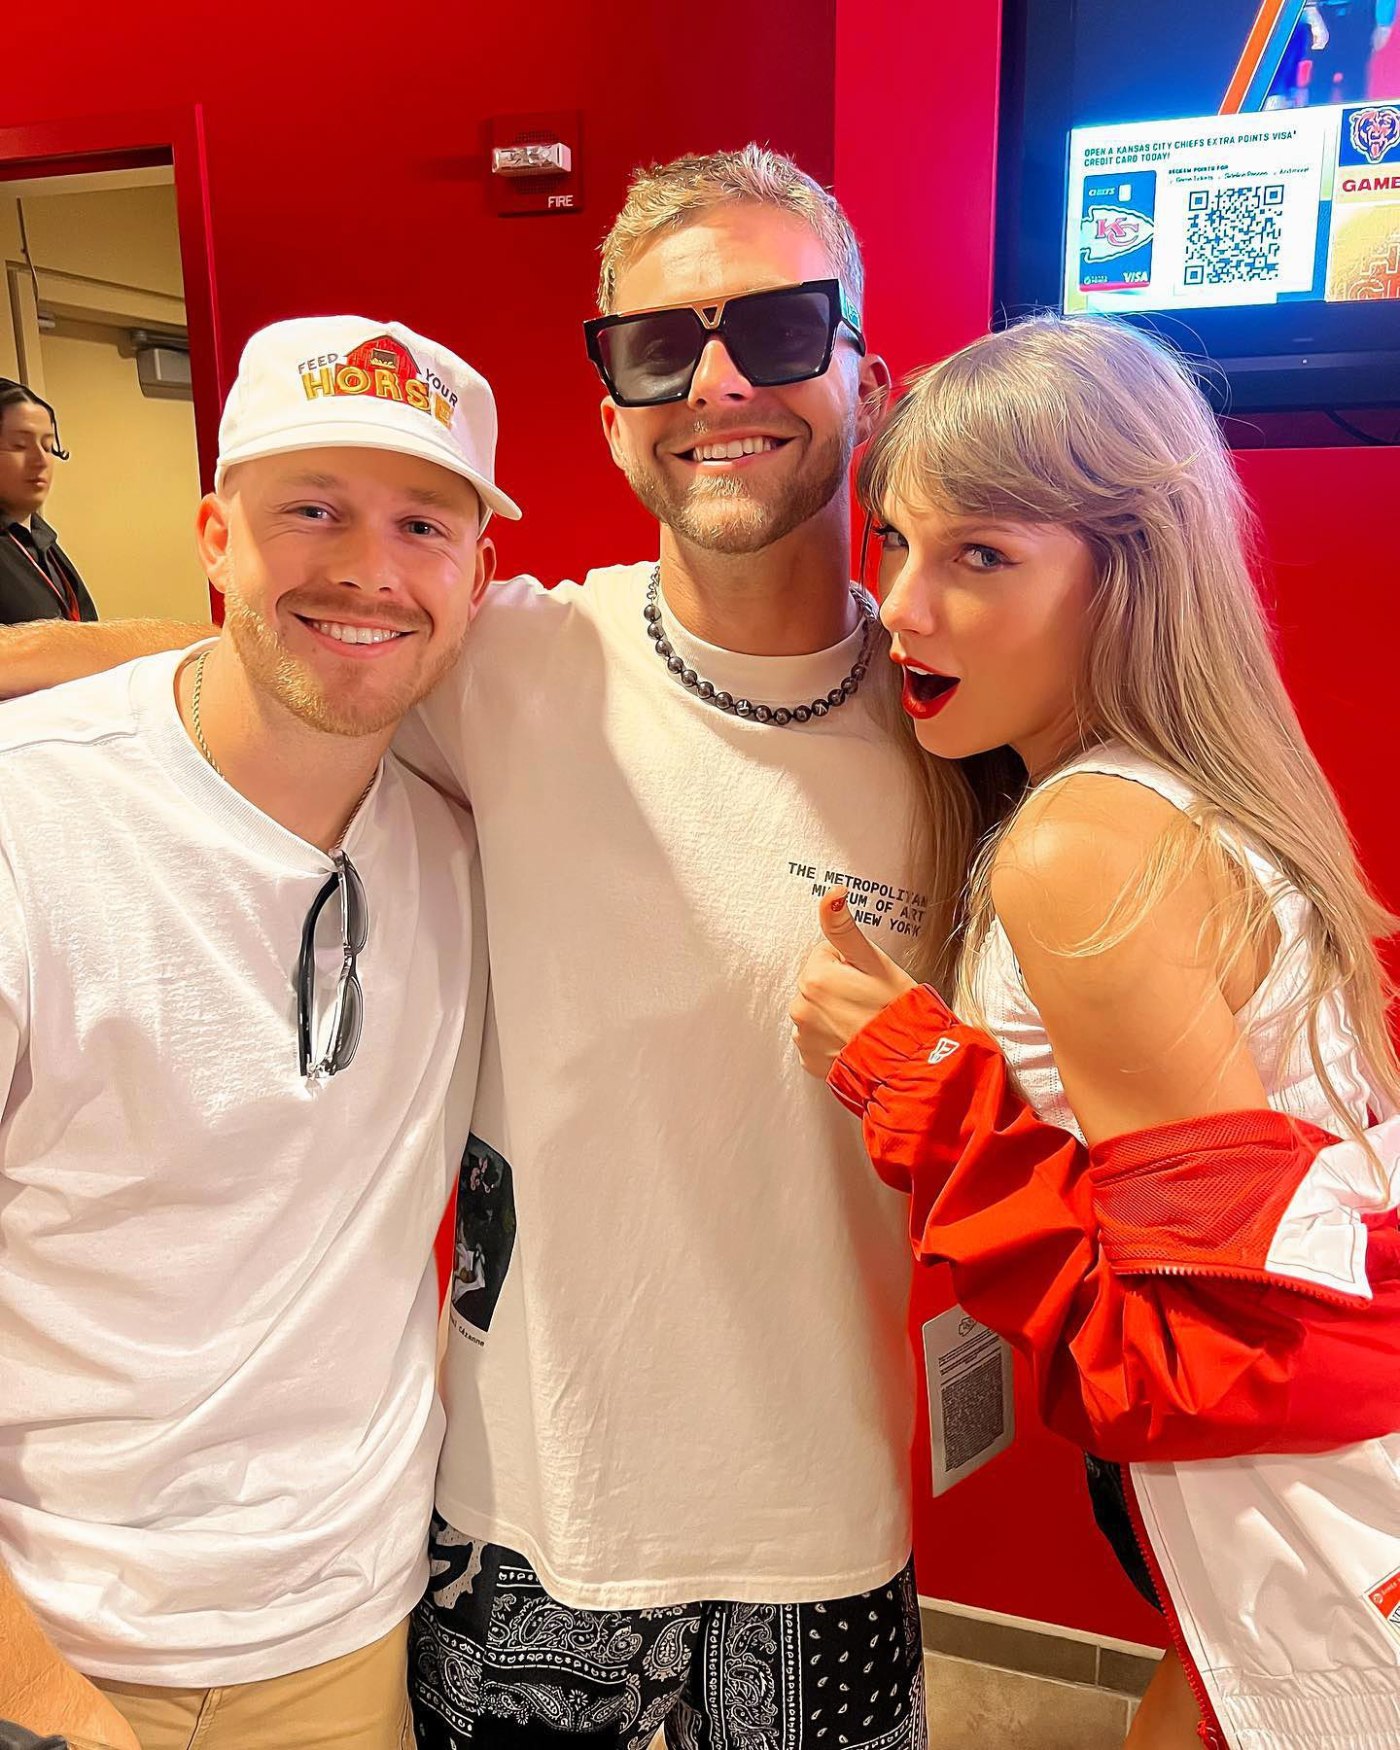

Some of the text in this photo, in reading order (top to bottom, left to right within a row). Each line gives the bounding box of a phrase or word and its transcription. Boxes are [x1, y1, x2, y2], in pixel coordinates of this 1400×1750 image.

[1084, 147, 1106, 157] OPEN
[1108, 147, 1114, 155] A
[1117, 143, 1150, 154] KANSAS
[1153, 141, 1172, 151] CITY
[1174, 139, 1205, 149] CHIEFS
[1207, 137, 1235, 146] EXTRA
[1238, 133, 1270, 143] POINTS
[1084, 153, 1170, 167] CREDIT CARD TODAY!
[1342, 176, 1400, 192] GAME
[548, 195, 573, 208] FIRE
[1123, 271, 1149, 283] VISA
[298, 353, 458, 407] FEED YOUR
[302, 365, 454, 430] HORSE
[788, 862, 816, 879] THE
[875, 899, 894, 913] OF
[900, 907, 926, 922] ART
[854, 910, 921, 937] NEW YORK
